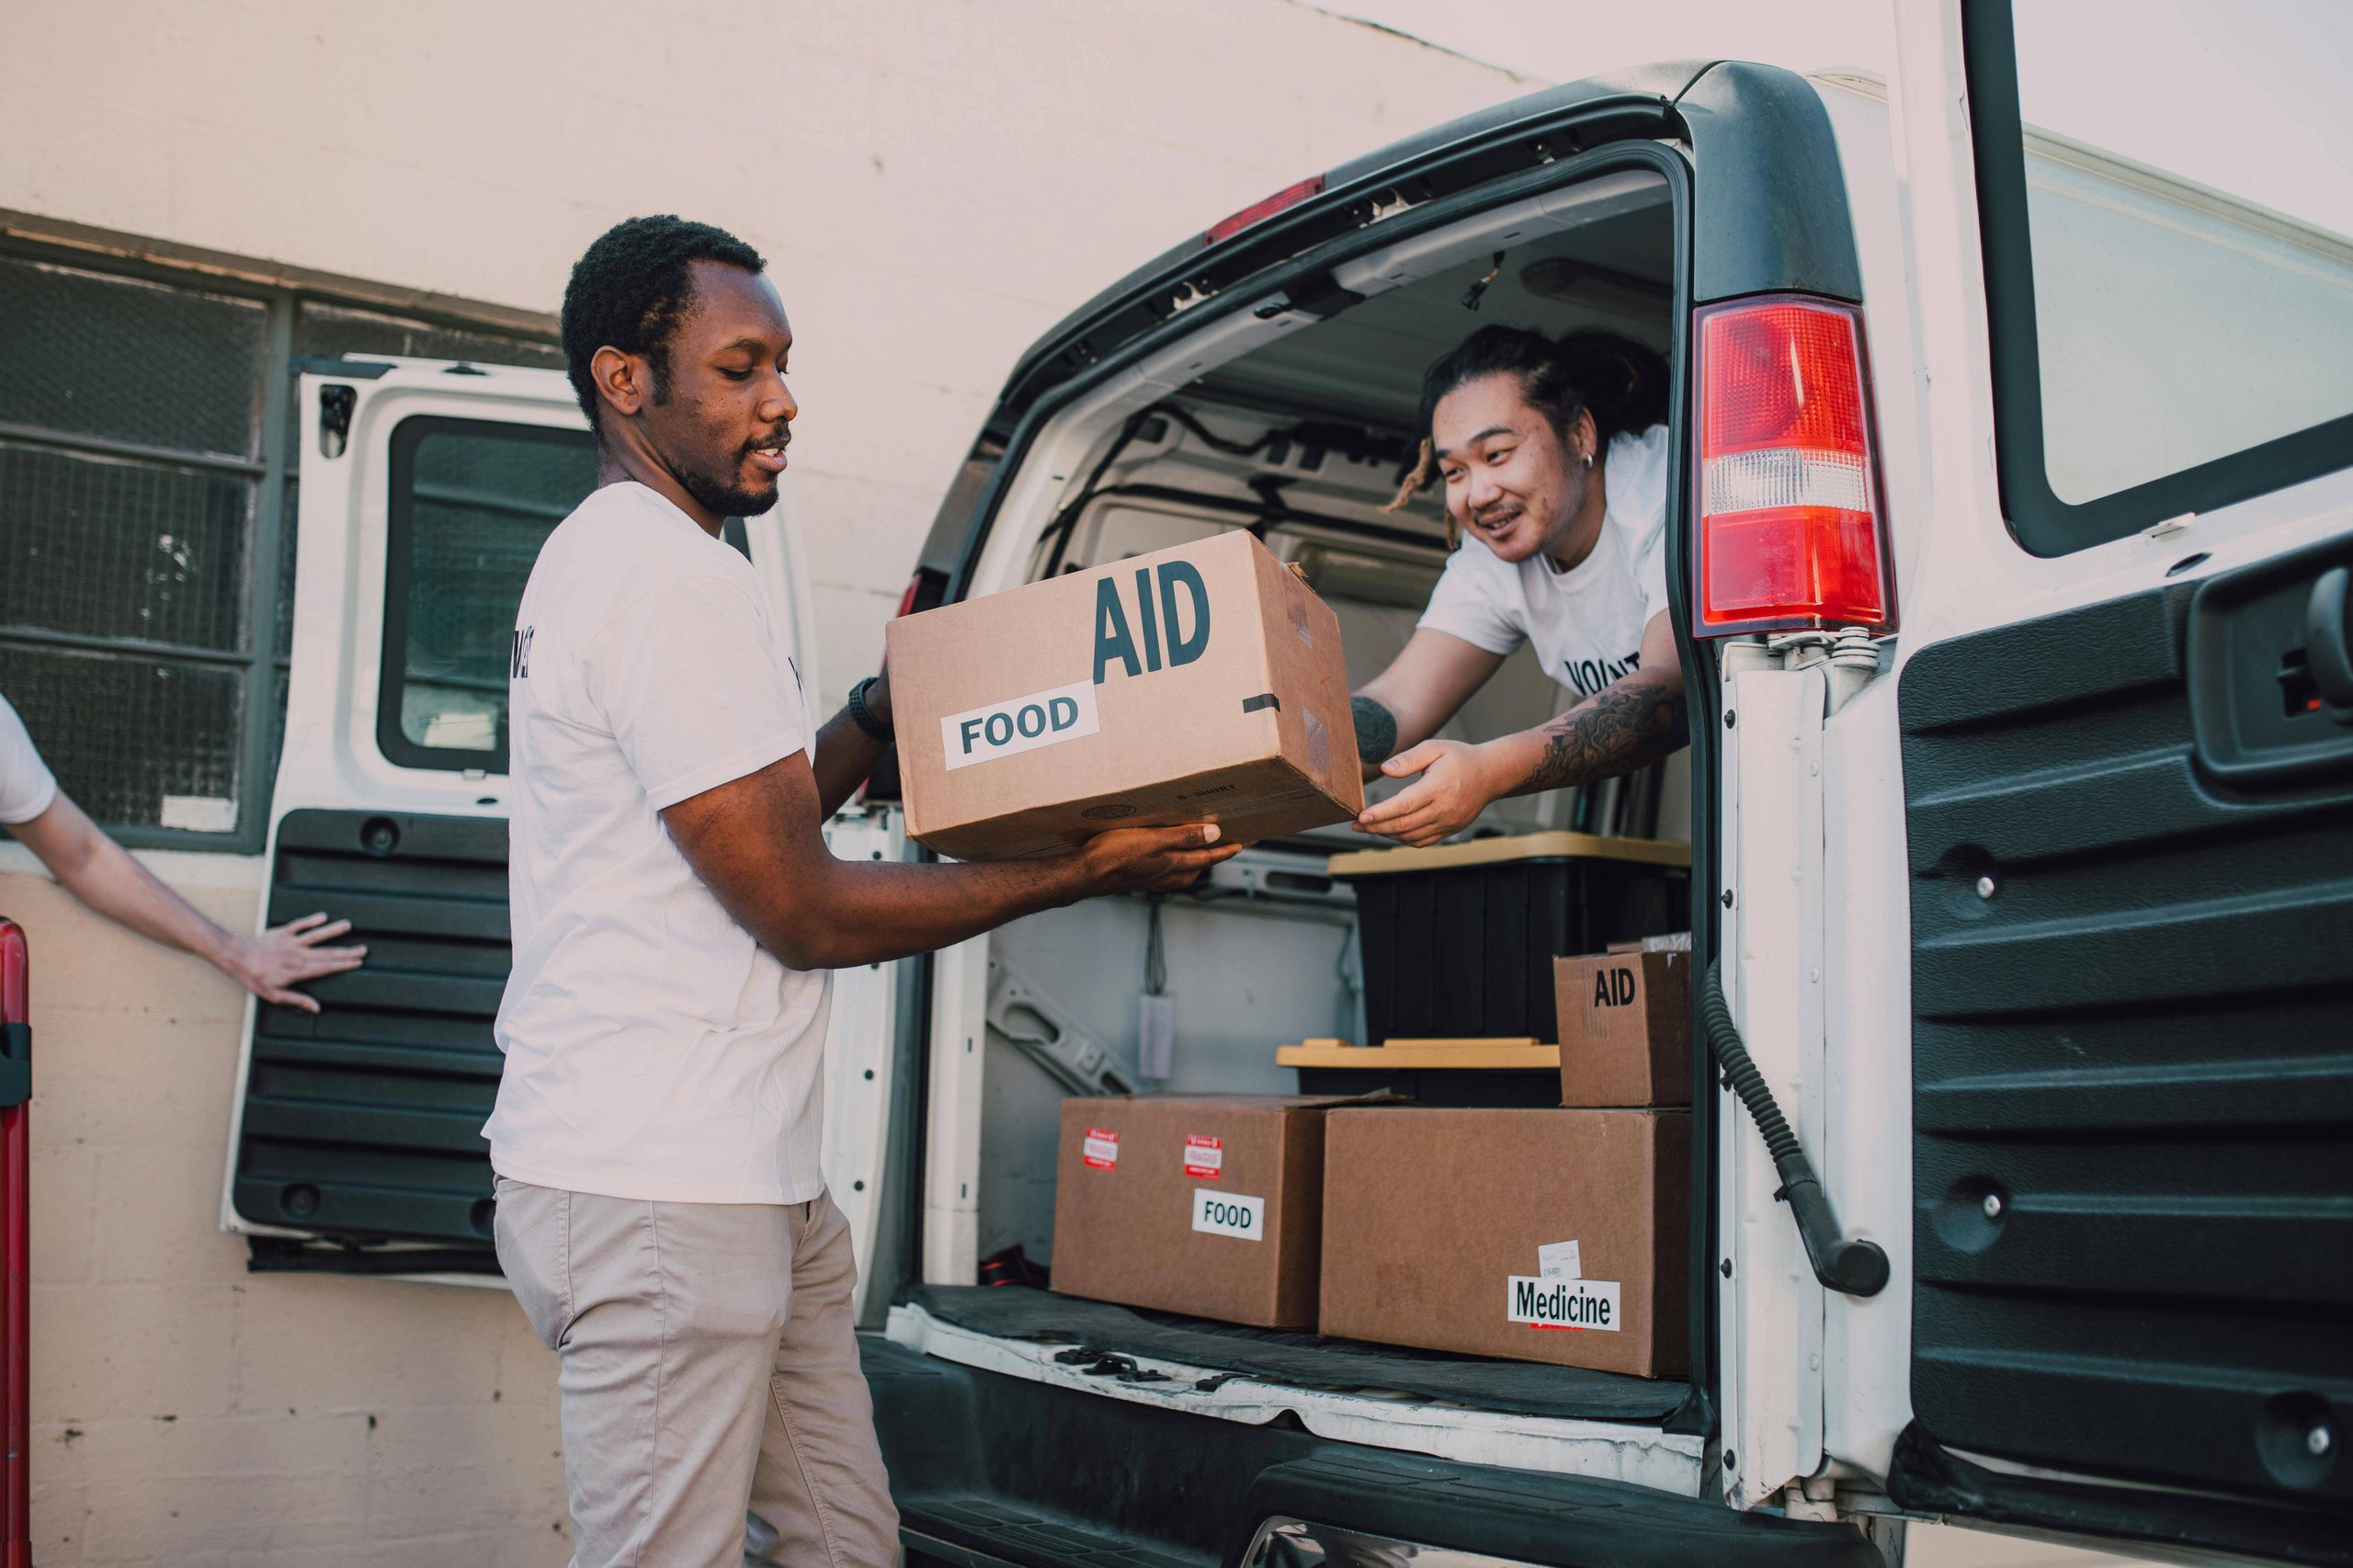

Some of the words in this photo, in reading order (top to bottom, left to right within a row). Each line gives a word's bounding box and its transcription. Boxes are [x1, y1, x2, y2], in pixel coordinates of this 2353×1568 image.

[1092, 560, 1211, 686] AID
[960, 696, 1079, 755] FOOD
[1595, 968, 1635, 1007] AID
[1204, 1200, 1252, 1229] FOOD
[1517, 1280, 1611, 1325] Medicine
